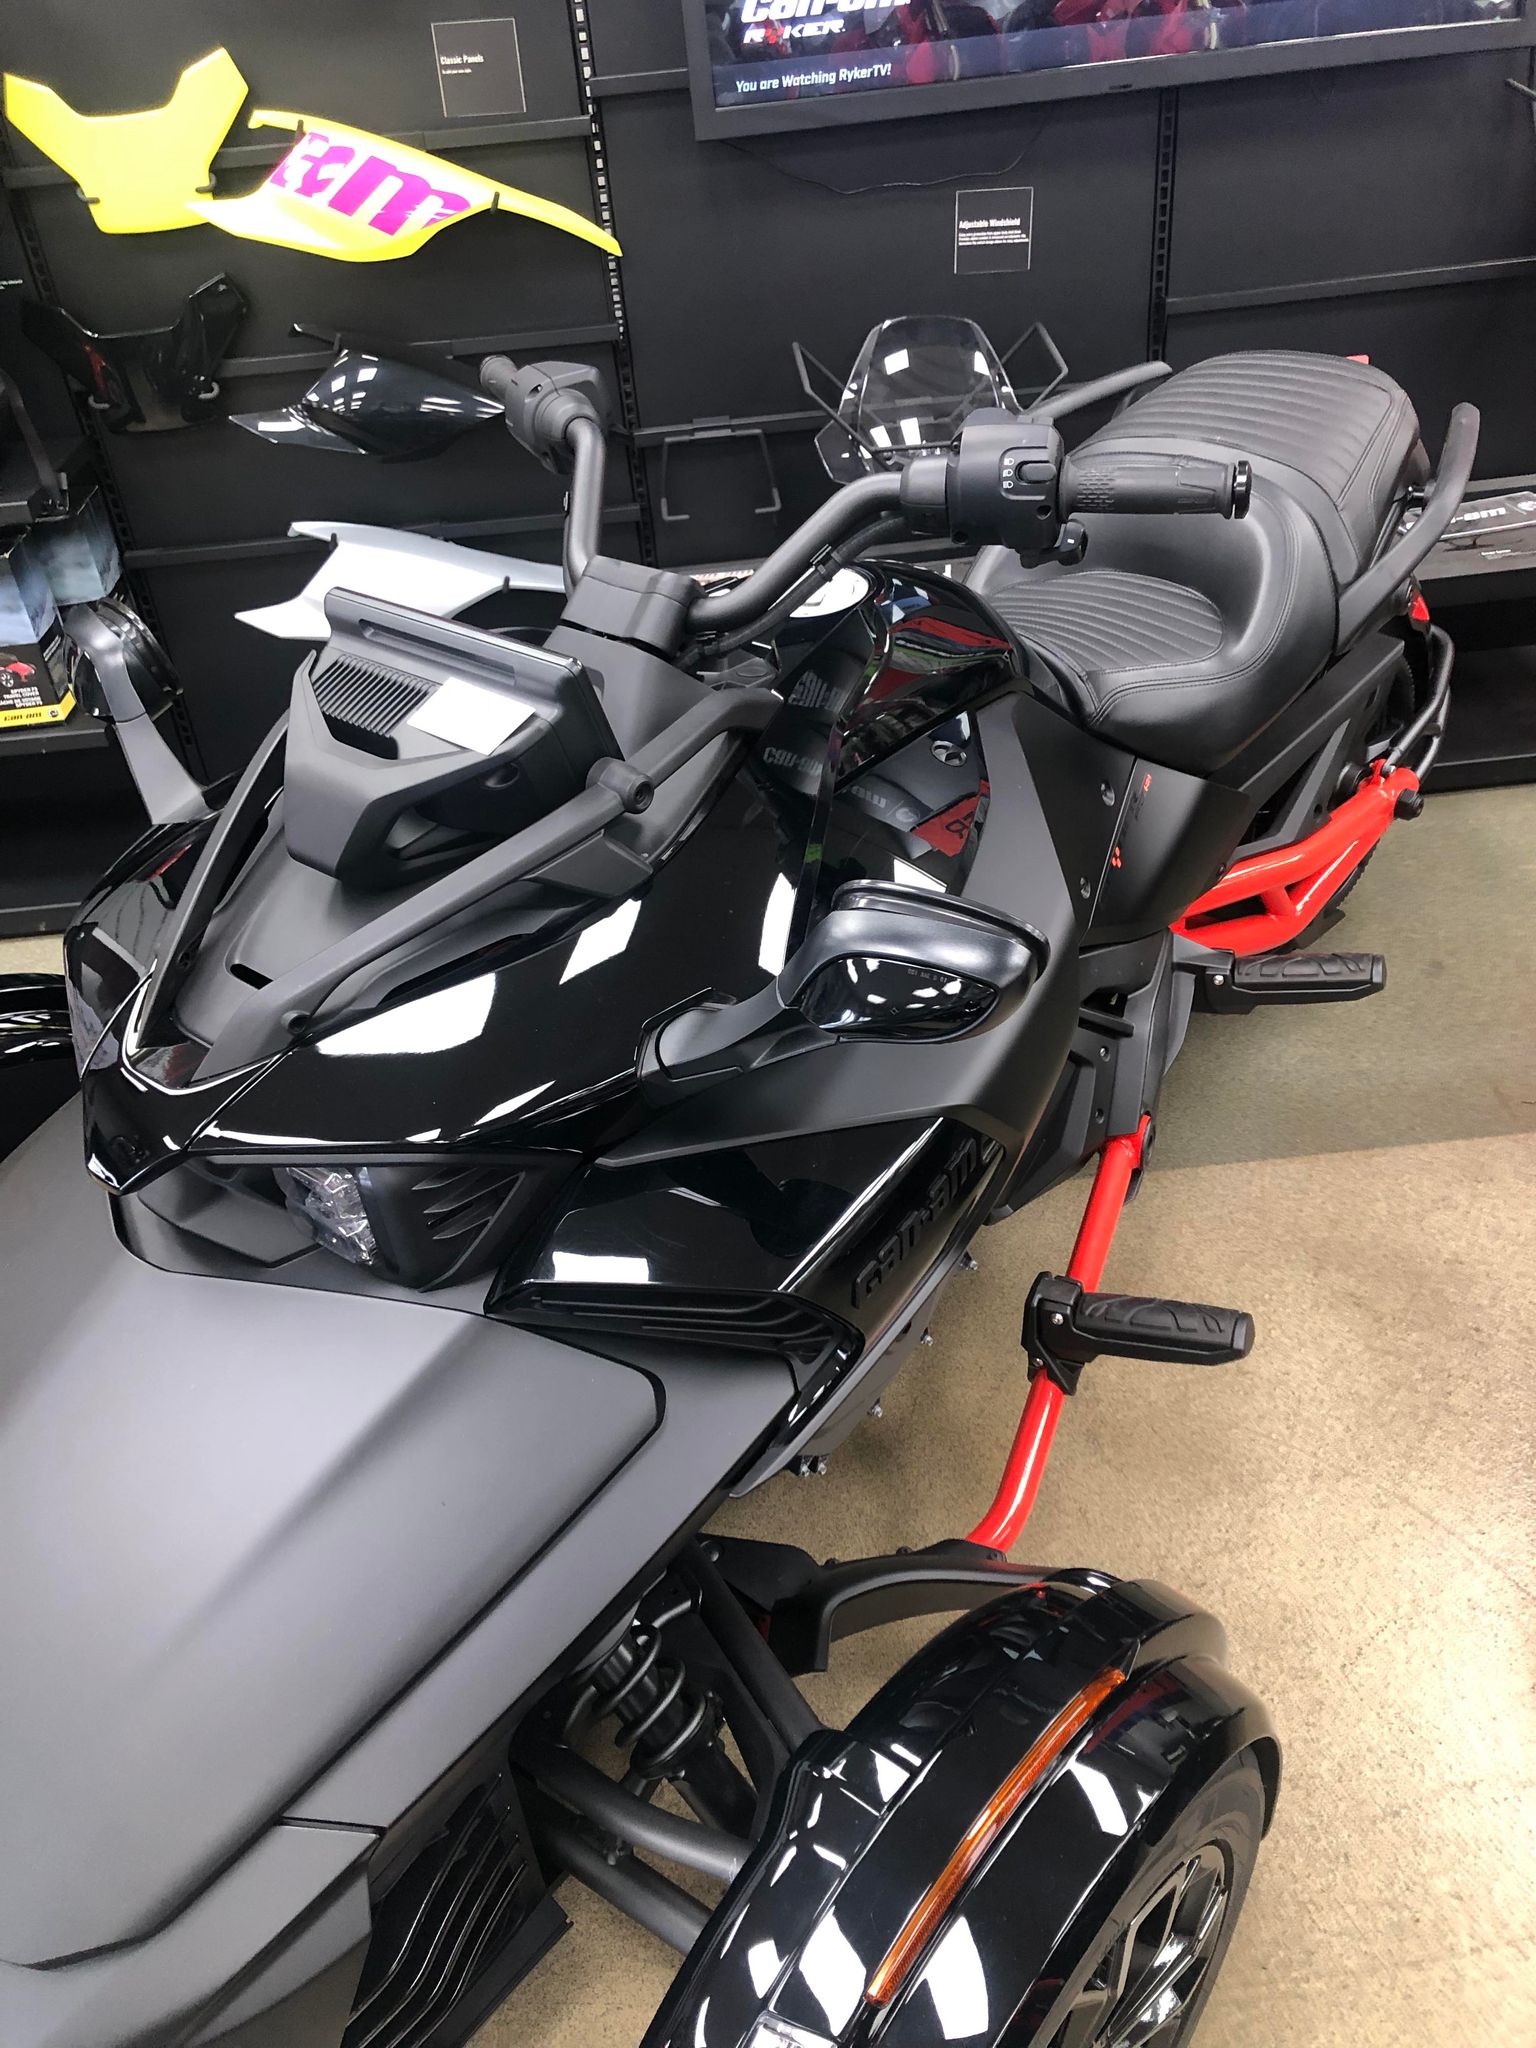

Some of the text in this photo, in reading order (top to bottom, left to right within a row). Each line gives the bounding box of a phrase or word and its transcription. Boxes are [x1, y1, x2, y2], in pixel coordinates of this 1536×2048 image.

[741, 0, 906, 23] can-
[440, 54, 484, 65] Classic Panels
[736, 63, 892, 93] You are Watching RykerTV!
[959, 217, 1021, 230] Adjustable Windshield
